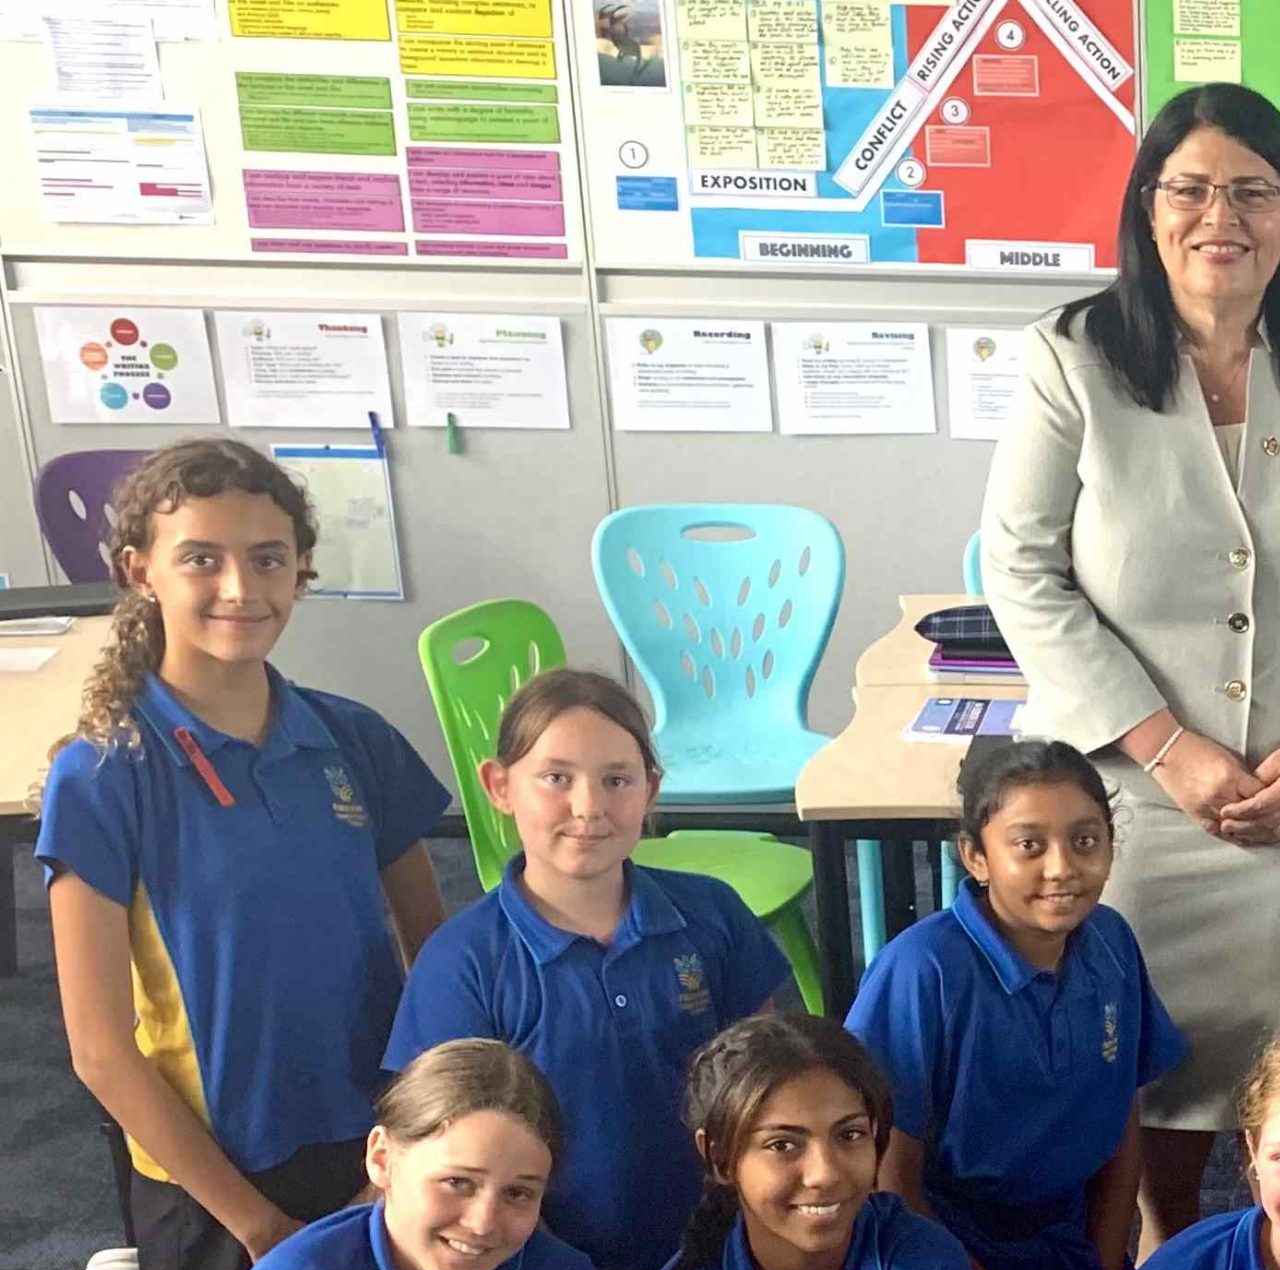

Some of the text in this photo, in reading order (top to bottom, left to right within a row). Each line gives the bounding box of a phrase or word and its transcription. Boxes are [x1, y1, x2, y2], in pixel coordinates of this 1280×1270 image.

[1007, 29, 1015, 40] 4
[917, 0, 981, 82] RISING ACTI
[1078, 34, 1120, 80] ACTION
[951, 105, 960, 117] 3
[855, 100, 907, 170] CONFLICT
[631, 148, 636, 159] 1
[906, 166, 915, 178] 2
[700, 174, 807, 191] EXPOSITION
[759, 242, 852, 258] BEGINNING
[1000, 251, 1060, 266] MIDDLE
[318, 324, 368, 333] Thinking
[496, 329, 547, 339] Planning
[693, 330, 751, 339] Recording
[872, 332, 915, 340] Revising
